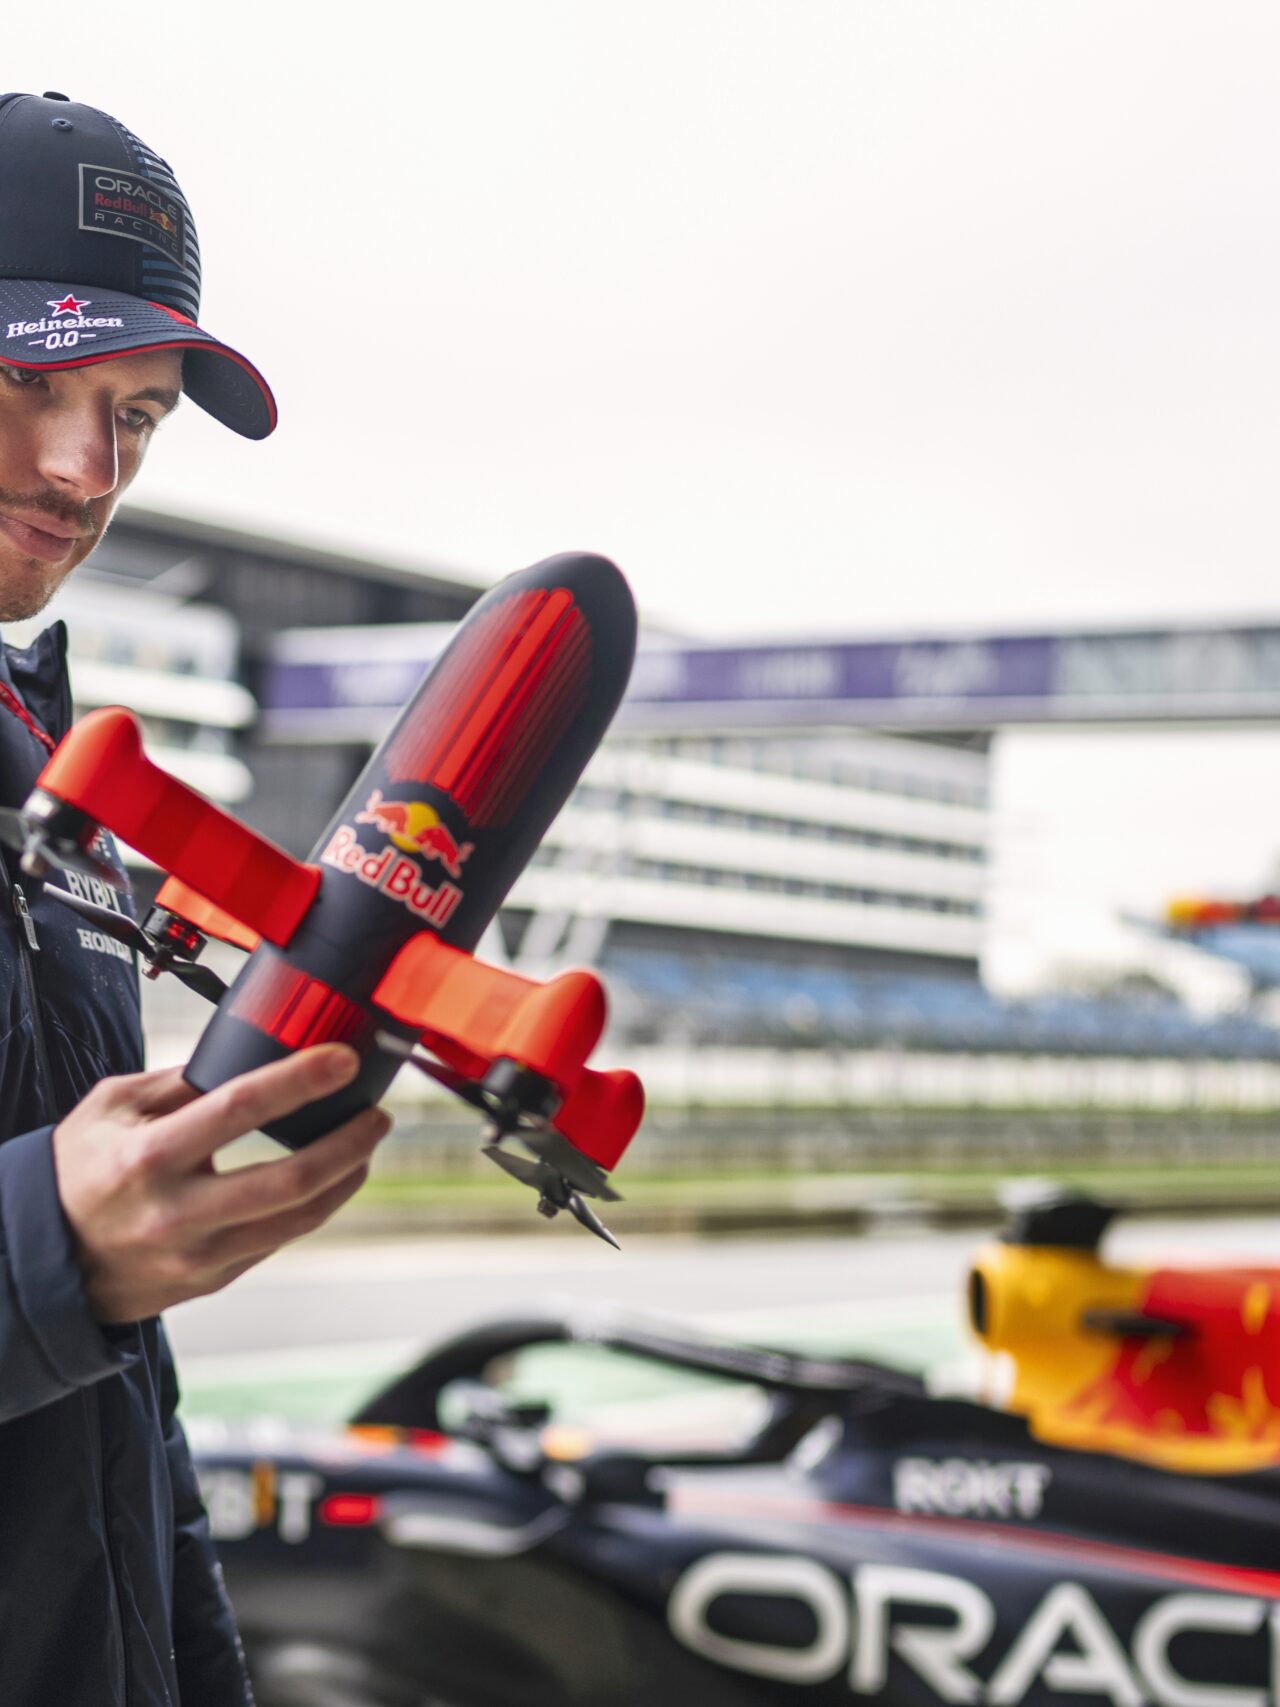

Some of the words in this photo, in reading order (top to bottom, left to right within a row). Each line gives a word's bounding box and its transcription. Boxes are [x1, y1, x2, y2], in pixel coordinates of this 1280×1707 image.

[95, 176, 177, 221] ORACLE
[95, 192, 122, 210] Red
[123, 198, 148, 217] Bull
[94, 212, 178, 253] RACING
[6, 315, 124, 338] Heineken
[320, 824, 399, 887] Red
[378, 853, 464, 929] Bull
[668, 1554, 1280, 1707] ORAC
